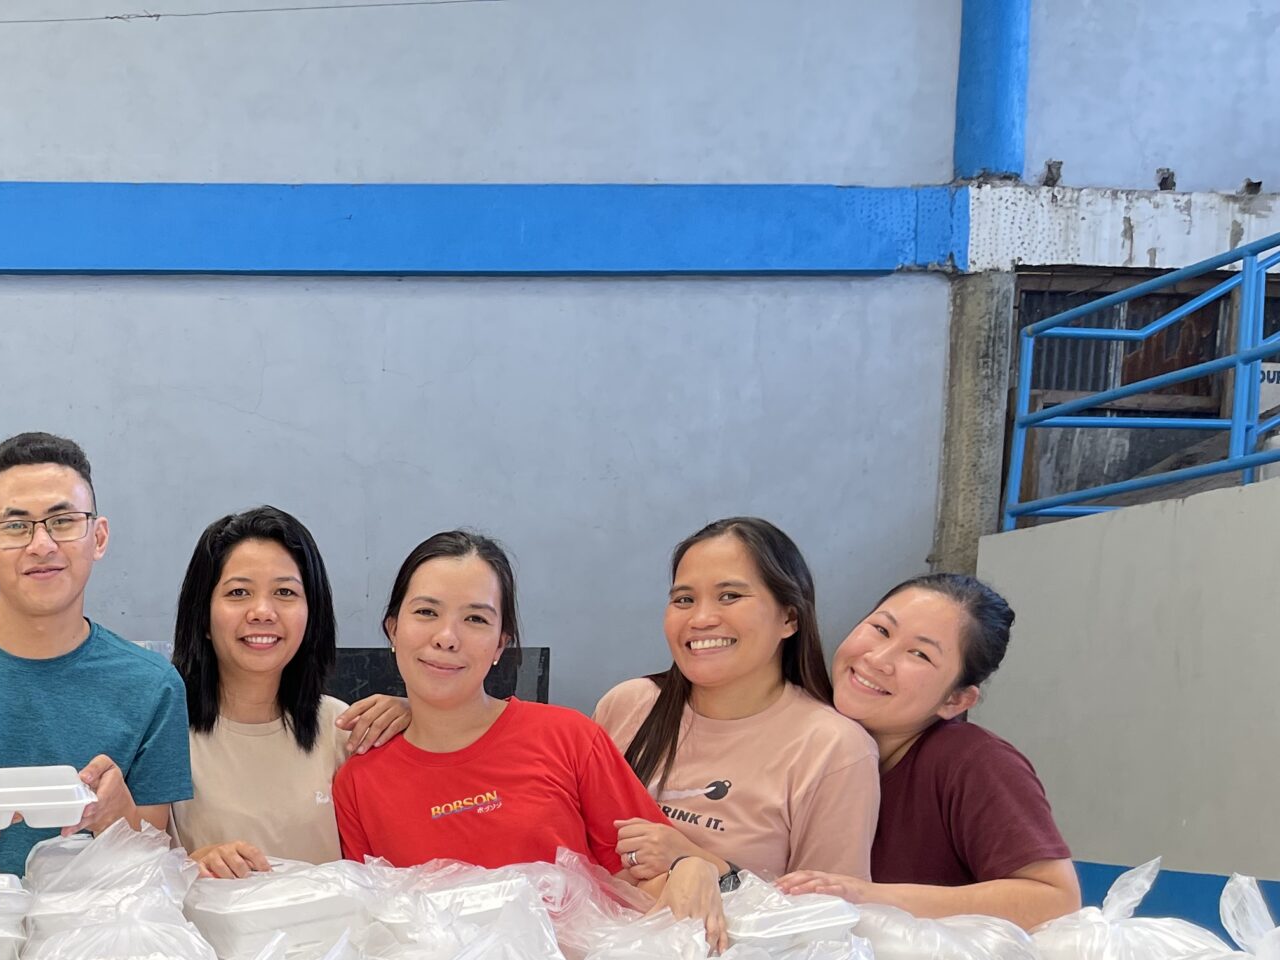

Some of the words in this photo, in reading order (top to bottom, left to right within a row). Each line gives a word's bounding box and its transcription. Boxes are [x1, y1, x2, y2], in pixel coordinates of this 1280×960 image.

[431, 790, 498, 818] BOBSON
[658, 804, 703, 825] RINK
[705, 817, 725, 831] IT.
